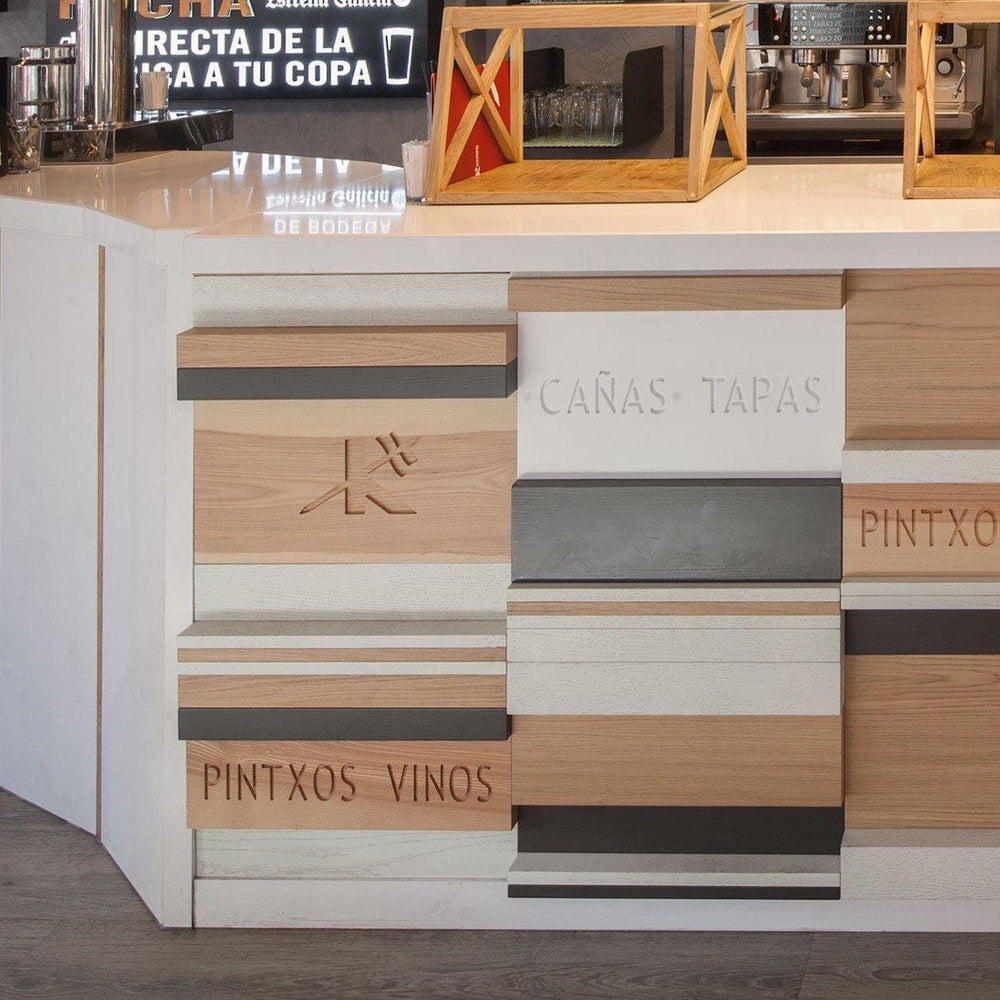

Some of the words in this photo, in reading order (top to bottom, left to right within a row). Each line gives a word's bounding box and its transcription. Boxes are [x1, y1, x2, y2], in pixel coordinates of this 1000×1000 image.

[134, 28, 250, 56] IRECTA
[262, 27, 303, 54] DE
[315, 27, 354, 54] LA
[204, 61, 225, 88] A
[233, 60, 273, 87] TU
[285, 59, 372, 87] COPA
[540, 370, 666, 415] CAÑAS
[702, 376, 823, 414] TAPAS
[204, 763, 357, 802] PINTXOS
[387, 764, 494, 802] VINOS
